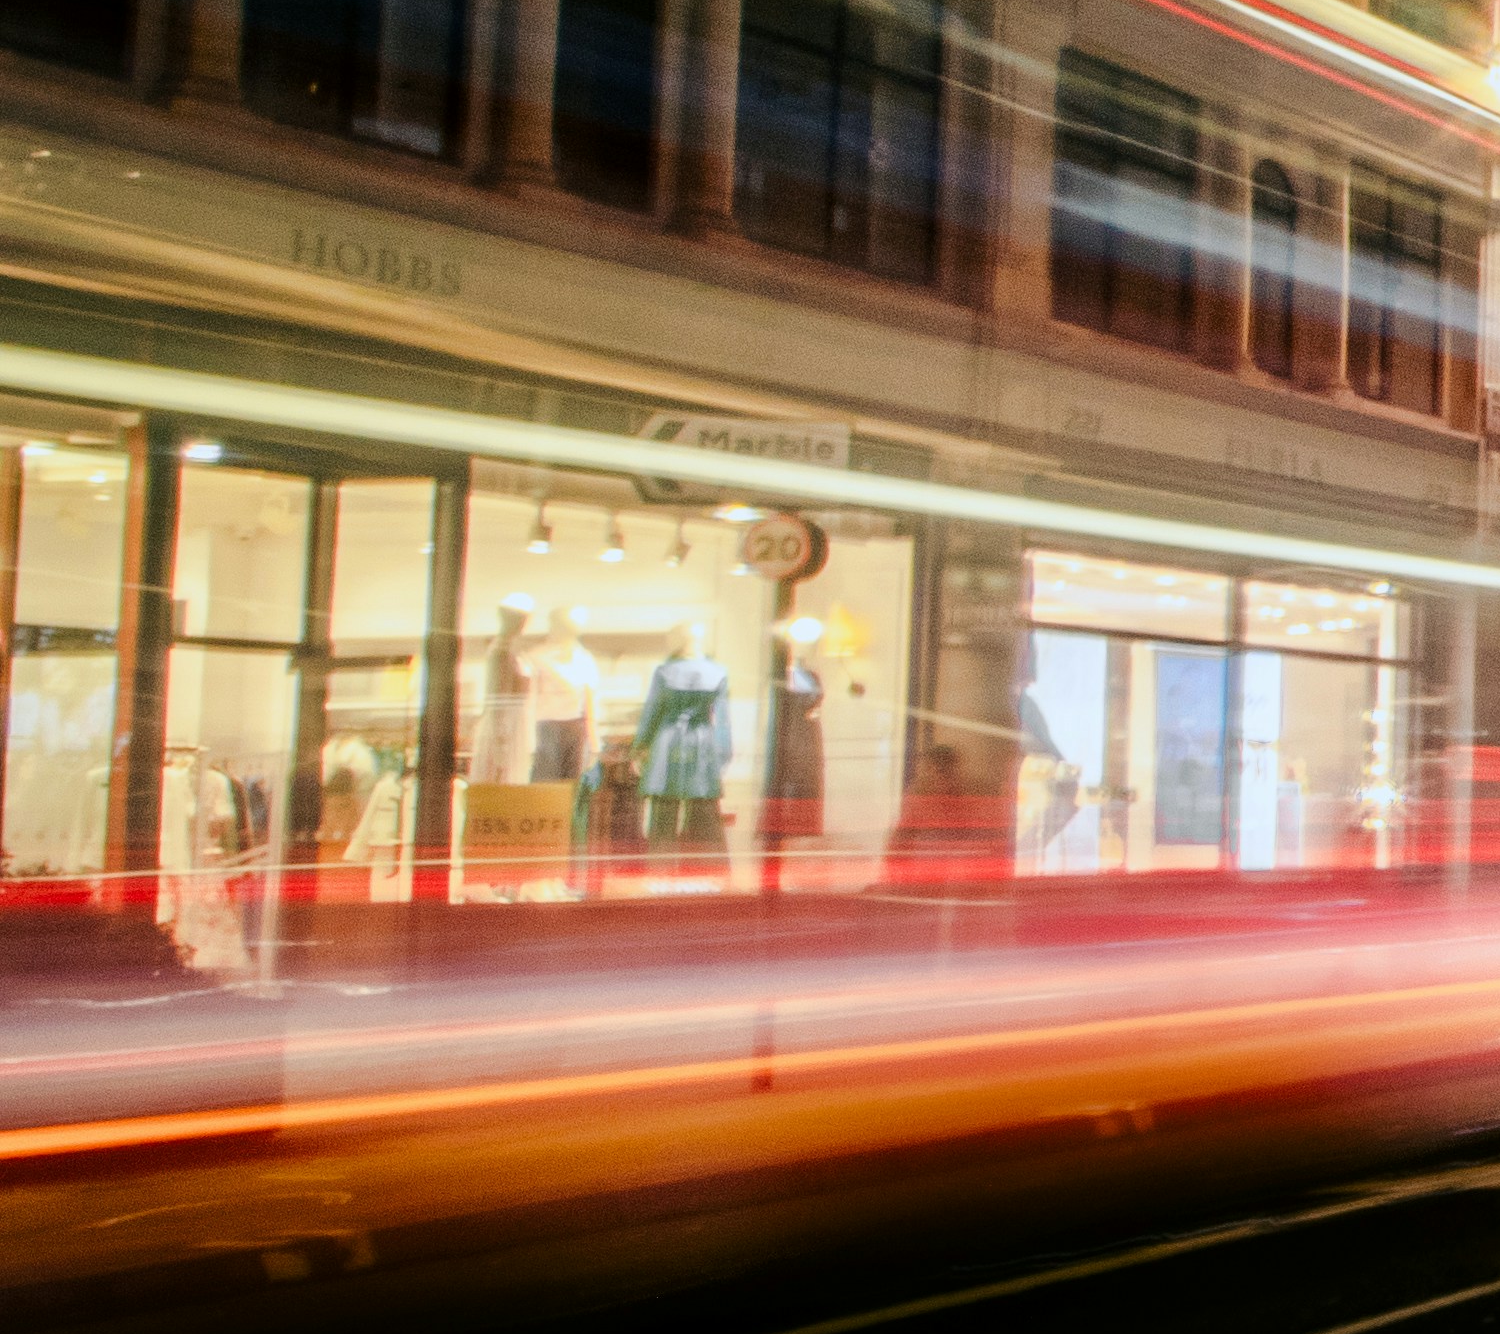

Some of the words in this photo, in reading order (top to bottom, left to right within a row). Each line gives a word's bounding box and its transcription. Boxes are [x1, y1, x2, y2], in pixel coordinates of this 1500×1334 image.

[291, 228, 463, 297] HOBBS
[698, 430, 836, 462] Marble
[755, 536, 800, 561] 20
[519, 818, 563, 835] OFF
